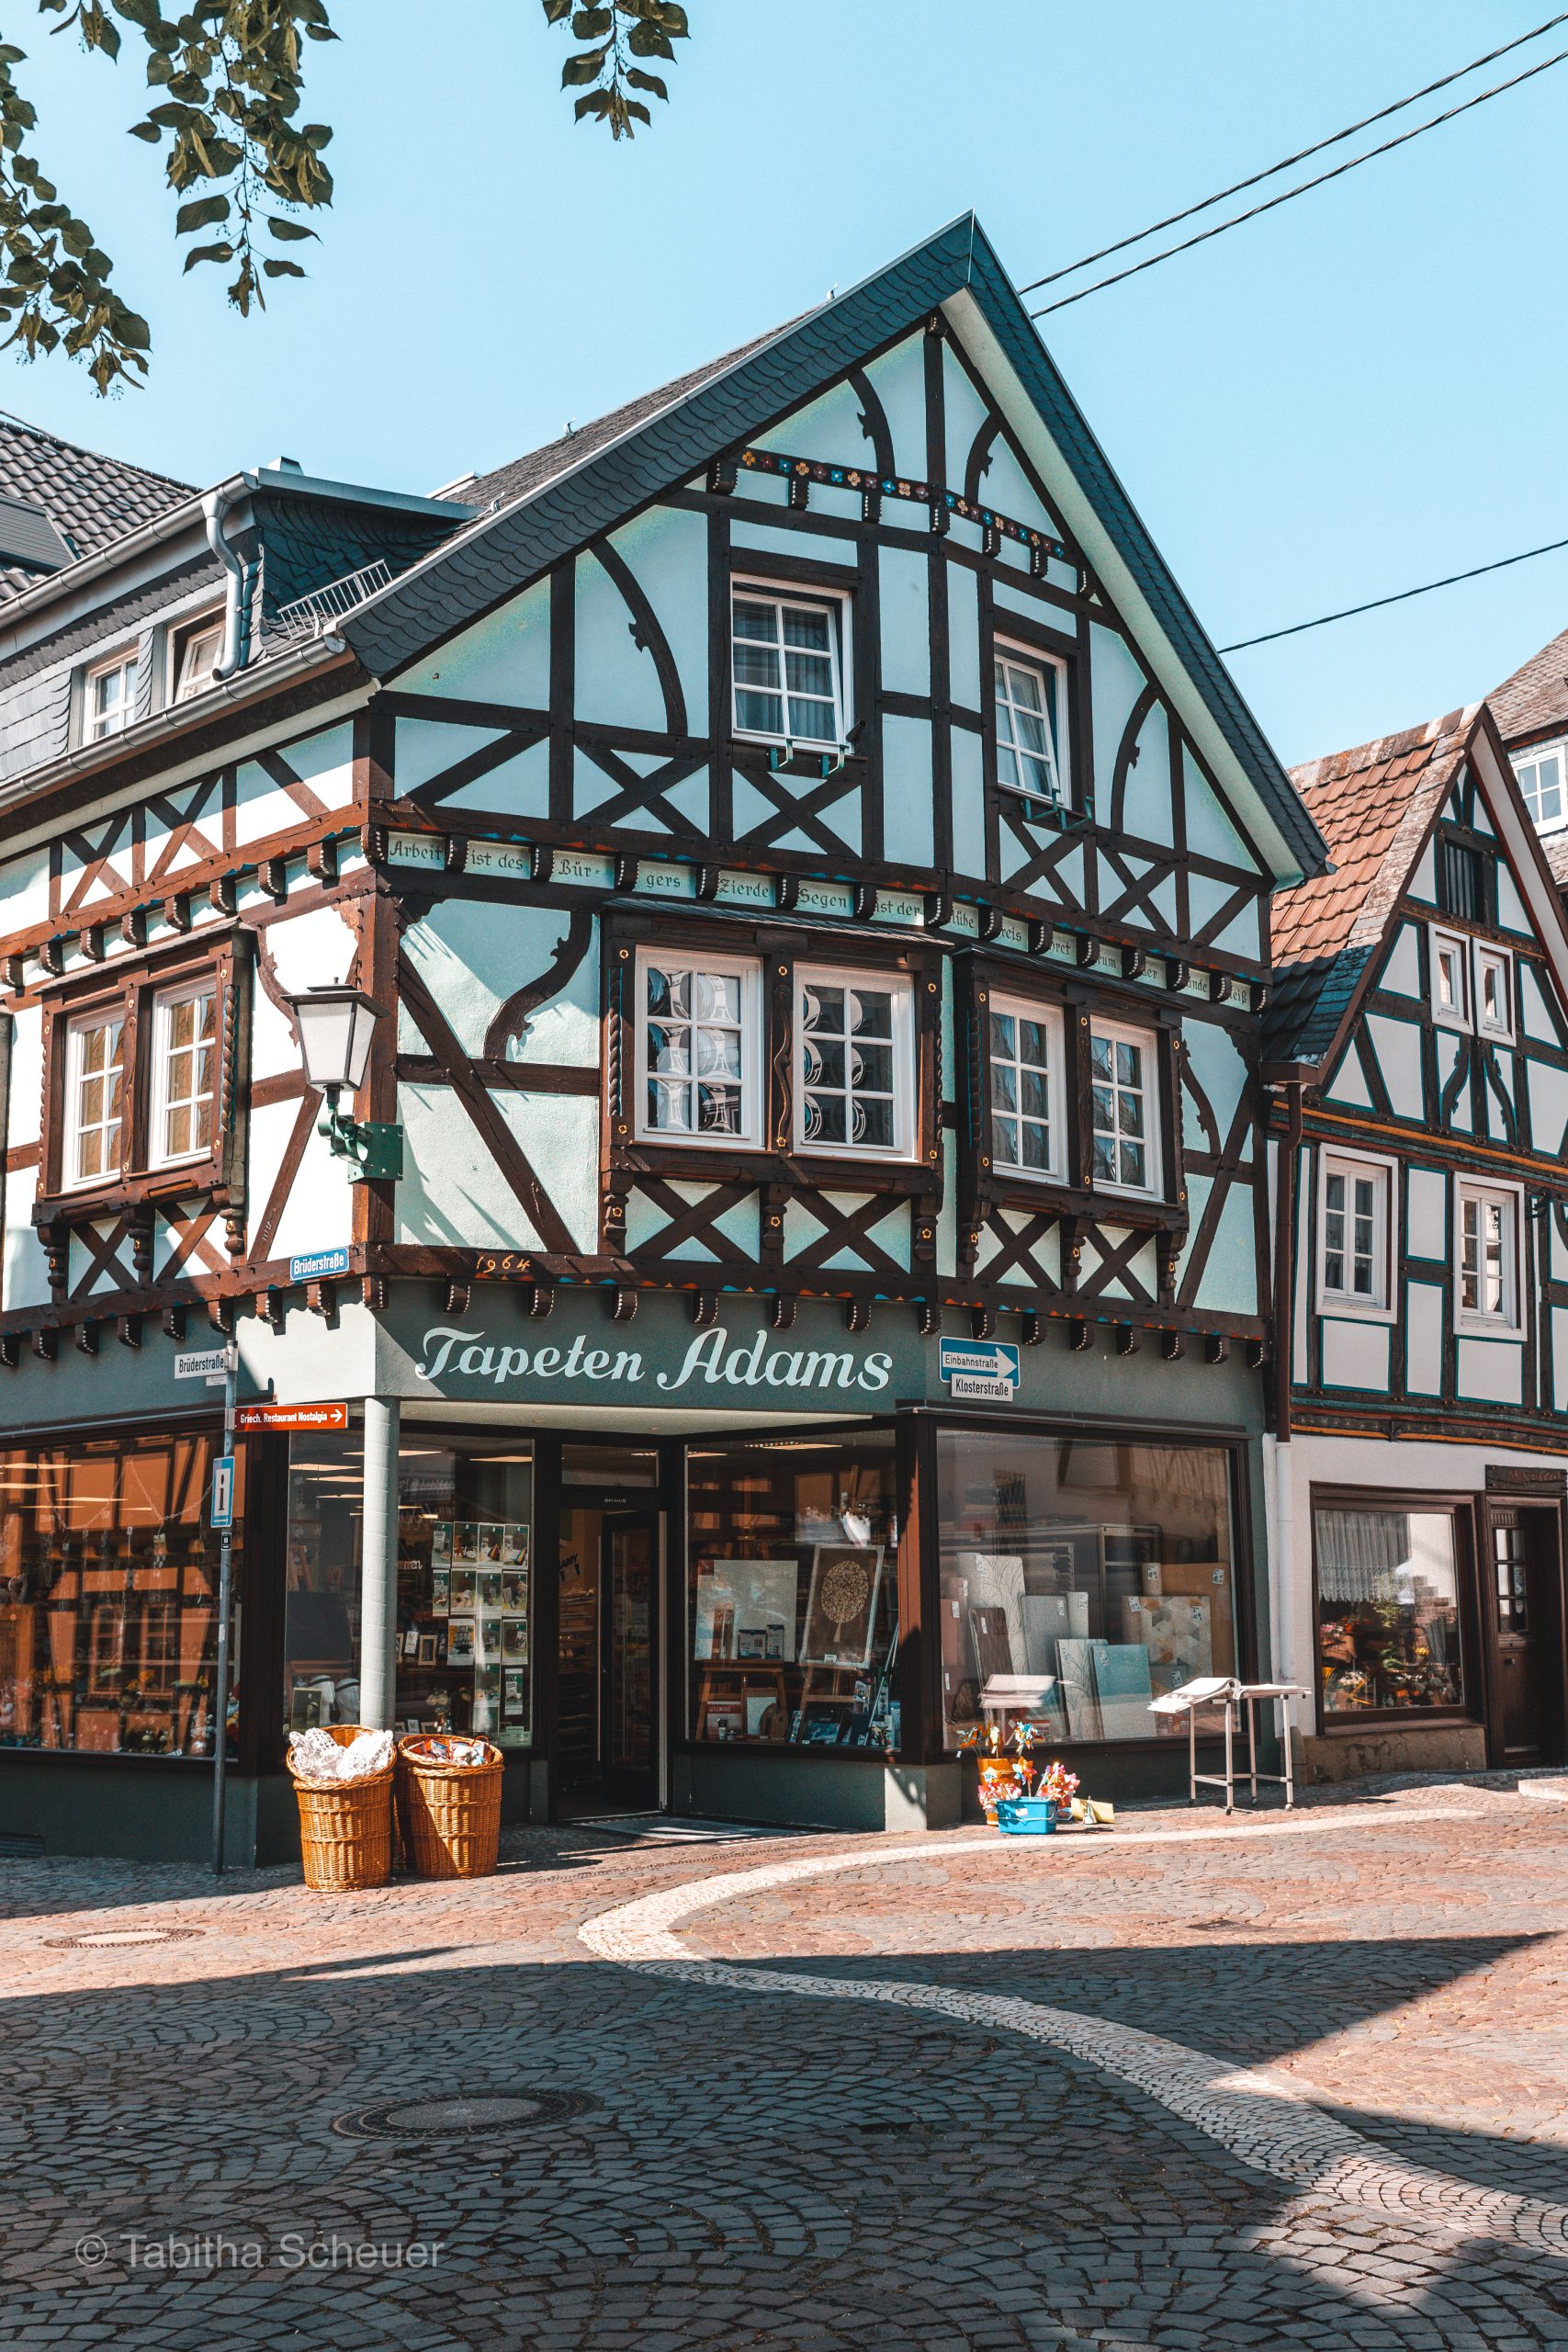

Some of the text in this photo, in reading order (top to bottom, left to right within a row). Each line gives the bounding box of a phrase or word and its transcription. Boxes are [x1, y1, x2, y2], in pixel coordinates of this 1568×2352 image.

[389, 840, 444, 861] Arbeit
[471, 849, 491, 866] ist
[498, 853, 524, 870] des
[646, 874, 681, 889] gers
[718, 878, 770, 898] Zierde
[799, 888, 847, 909] Segen
[897, 901, 920, 917] der
[999, 926, 1022, 942] reis
[294, 1252, 344, 1275] Brüderstraße
[476, 1254, 531, 1273] 1964
[178, 1354, 224, 1373] Brüderstraße
[414, 1327, 893, 1391] Tapeten Adams
[945, 1353, 998, 1369] Einbahnstraße
[955, 1378, 1009, 1396] Klosterstraße
[240, 1410, 328, 1424] Griech. Restaurant Nostalgia
